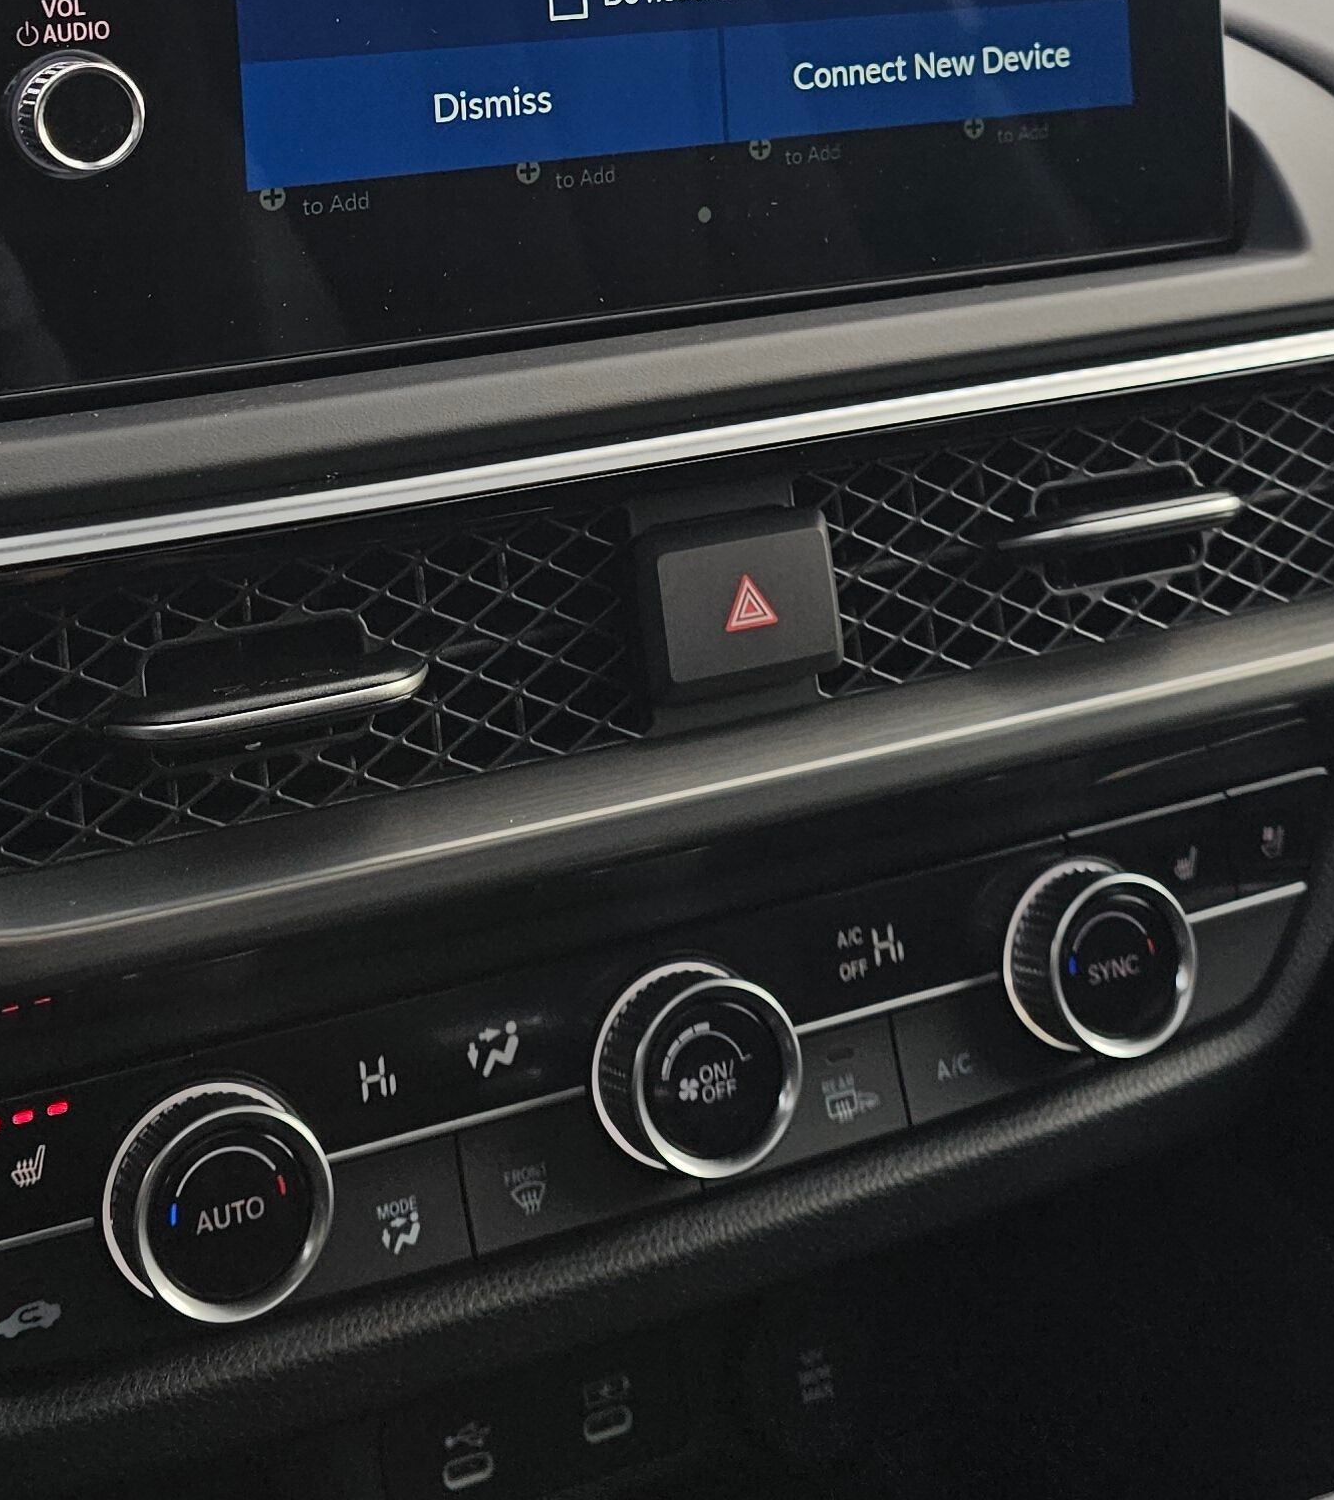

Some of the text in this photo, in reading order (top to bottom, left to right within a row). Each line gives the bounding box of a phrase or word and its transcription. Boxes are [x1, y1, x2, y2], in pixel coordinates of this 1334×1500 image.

[42, 20, 110, 44] AUDIO
[793, 41, 1071, 90] Connect New Device
[433, 85, 553, 123] Dismiss
[784, 150, 803, 166] to
[555, 166, 616, 189] to Add
[302, 190, 369, 216] to Add
[837, 926, 864, 949] A/C
[839, 957, 868, 983] OFF
[1088, 954, 1139, 986] SYNC
[937, 1052, 972, 1081] A/C
[701, 1077, 737, 1104] OFF
[195, 1196, 266, 1236] AUTO
[376, 1195, 417, 1221] MODE
